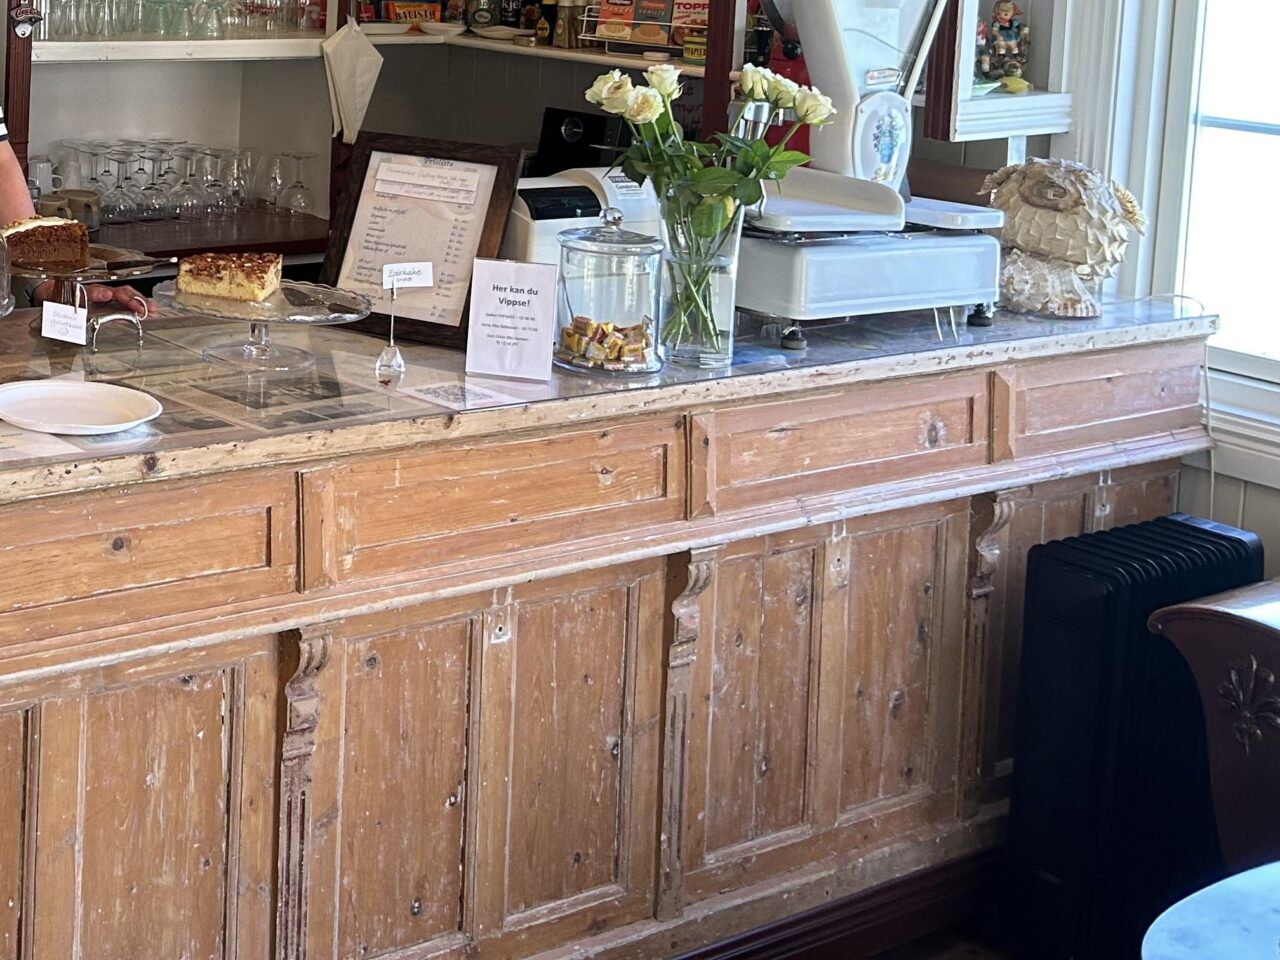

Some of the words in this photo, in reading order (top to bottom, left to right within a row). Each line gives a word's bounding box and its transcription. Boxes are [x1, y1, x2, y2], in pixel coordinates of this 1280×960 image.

[492, 284, 507, 293] Her
[509, 285, 525, 295] kan
[526, 287, 539, 296] du
[498, 297, 531, 308] Vippse!
